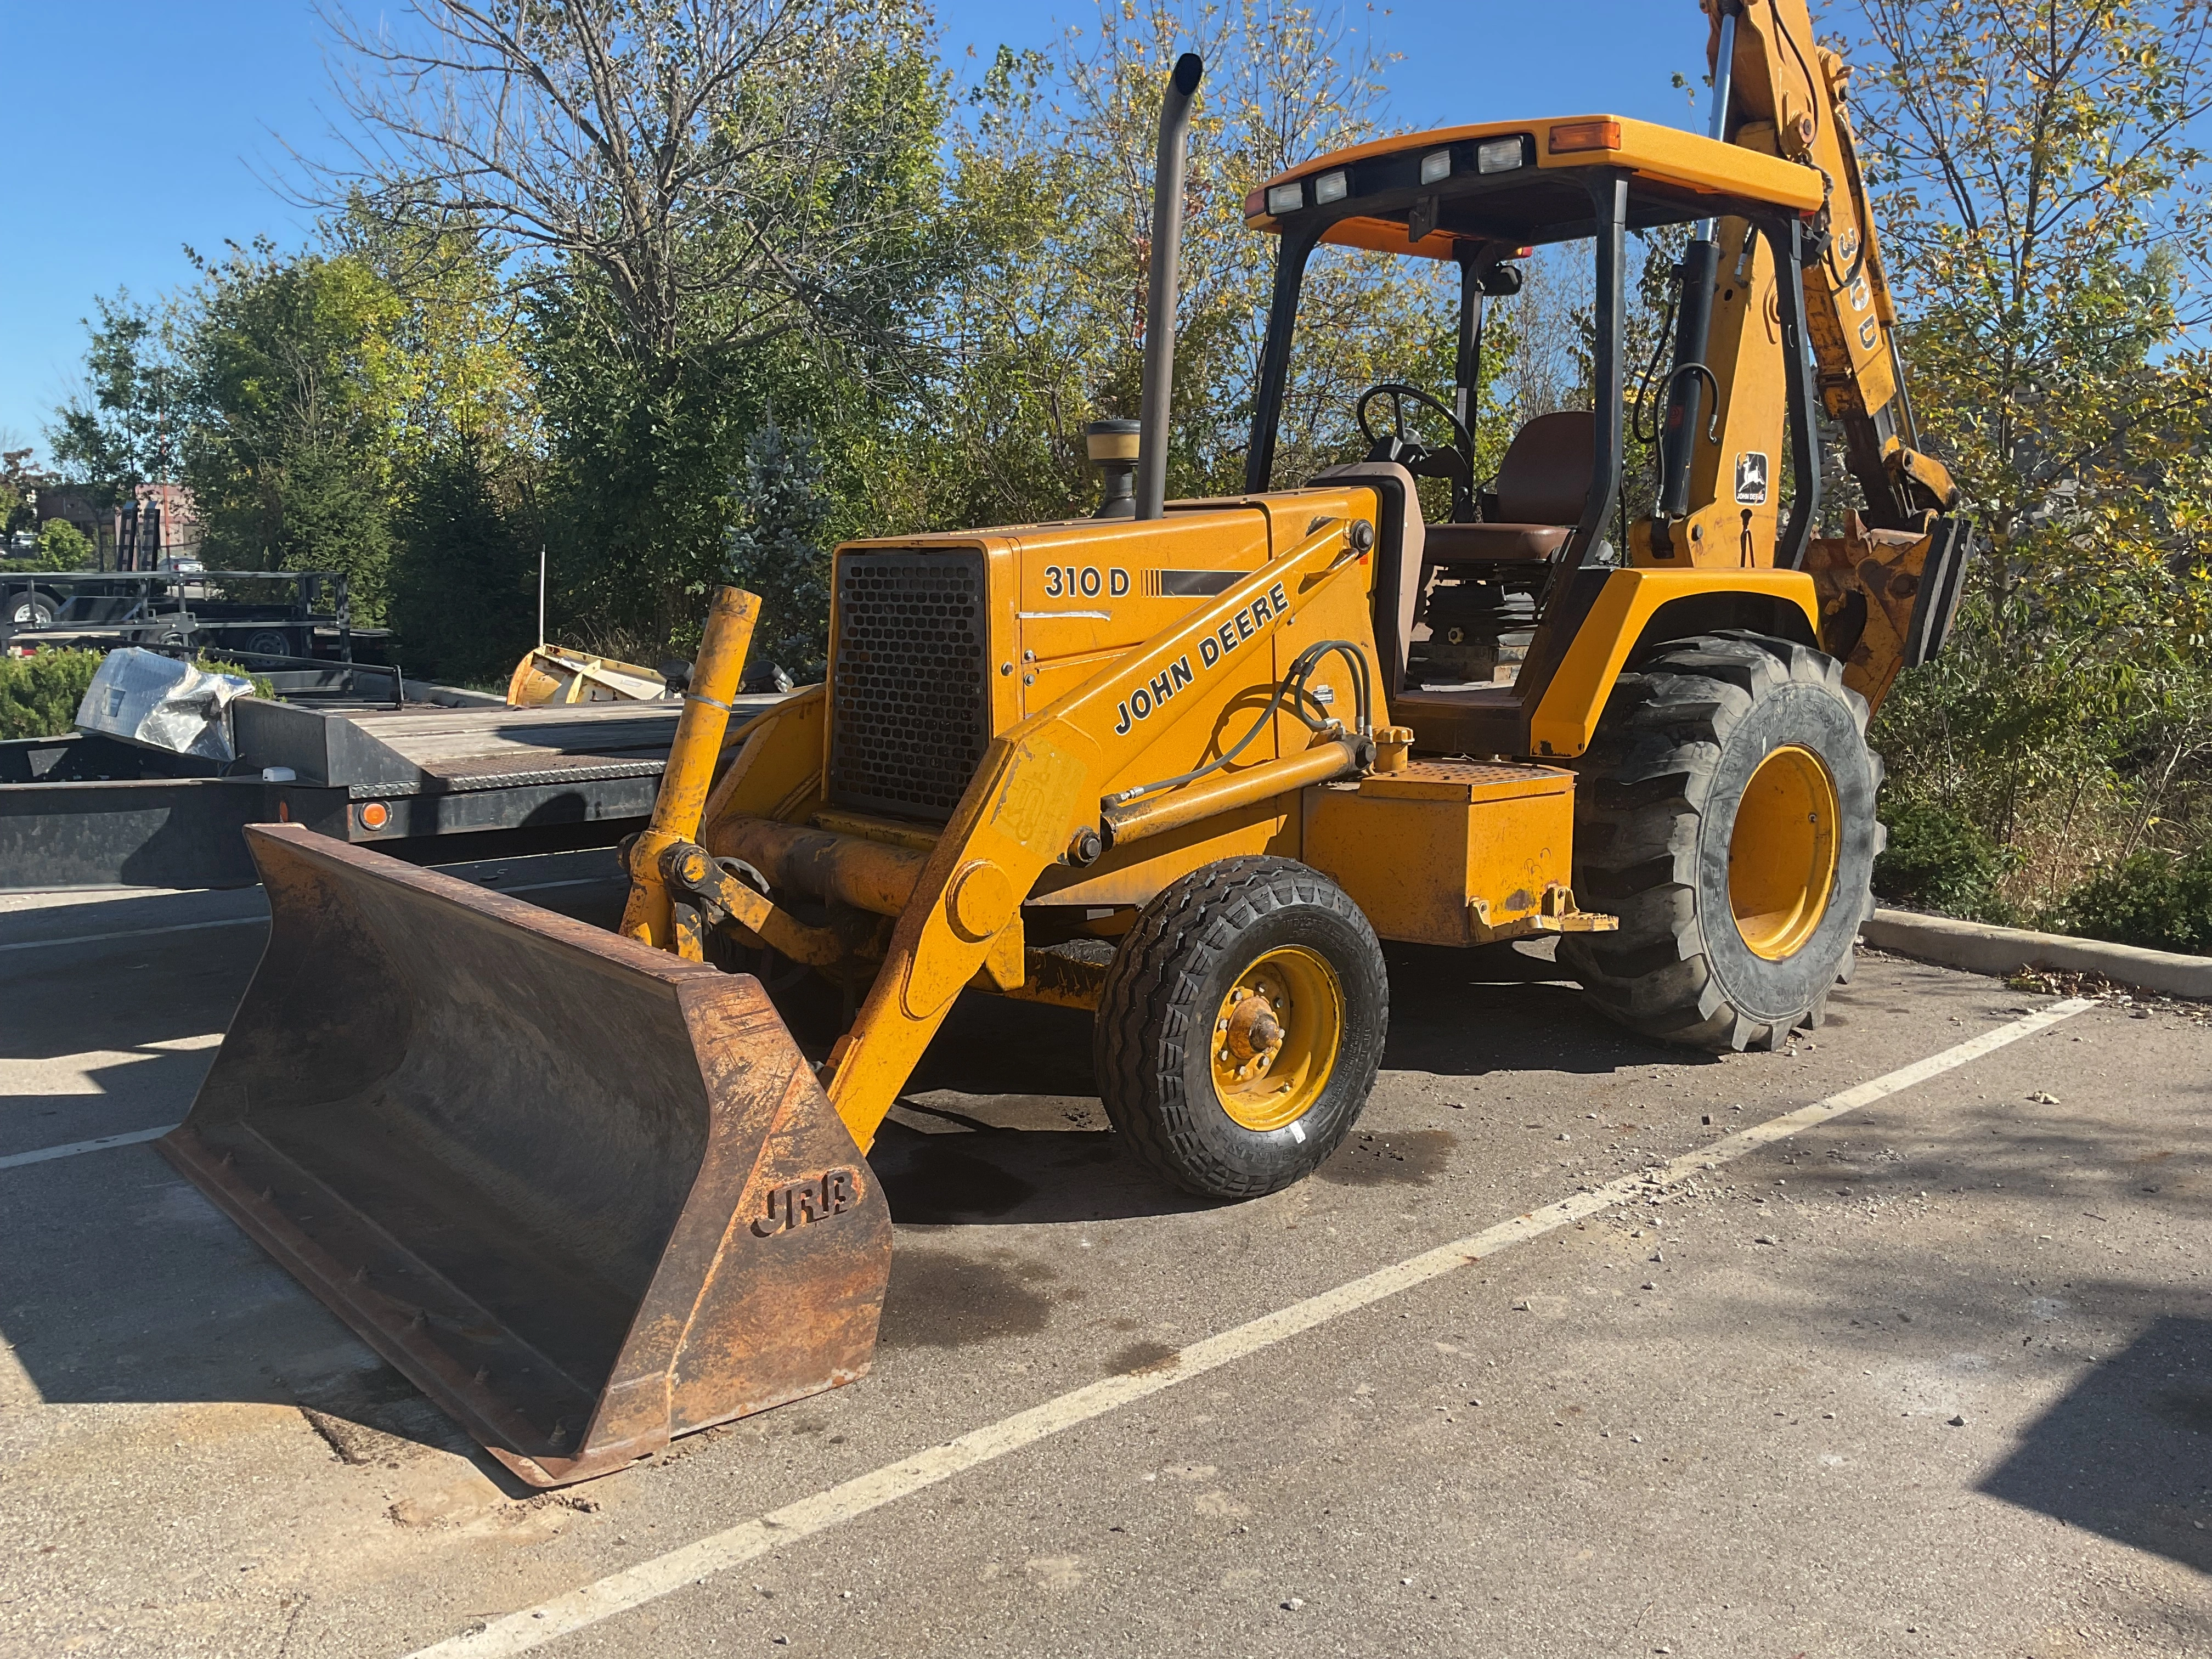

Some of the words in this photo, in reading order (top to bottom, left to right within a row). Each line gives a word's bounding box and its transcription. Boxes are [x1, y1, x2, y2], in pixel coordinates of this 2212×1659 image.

[1114, 653, 1194, 736] JOHN
[1198, 580, 1290, 670] DEERE
[1210, 1125, 1295, 1164] CARLISLE
[751, 1170, 857, 1238] JRB
